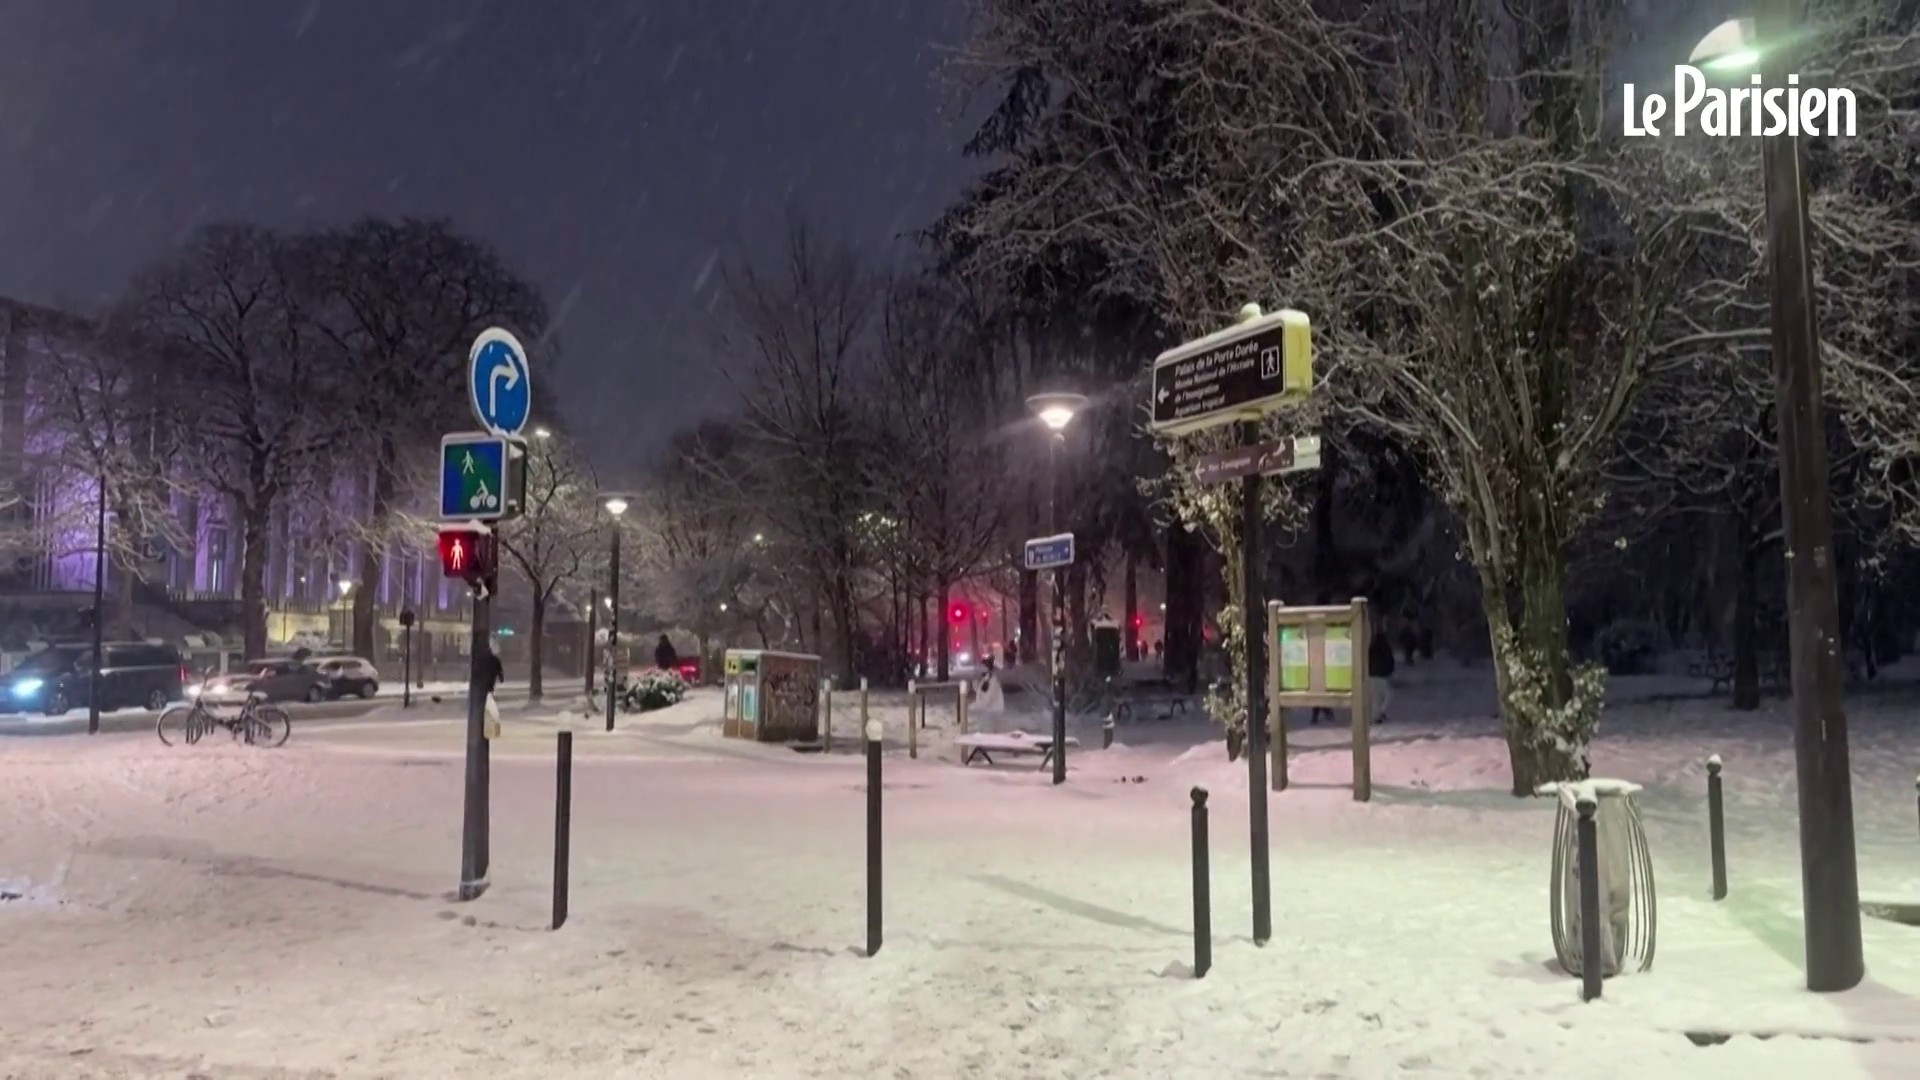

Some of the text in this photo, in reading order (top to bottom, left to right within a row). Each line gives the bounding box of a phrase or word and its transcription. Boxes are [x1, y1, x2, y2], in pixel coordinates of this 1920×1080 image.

[1176, 341, 1259, 377] Palais de la Porte Dorée
